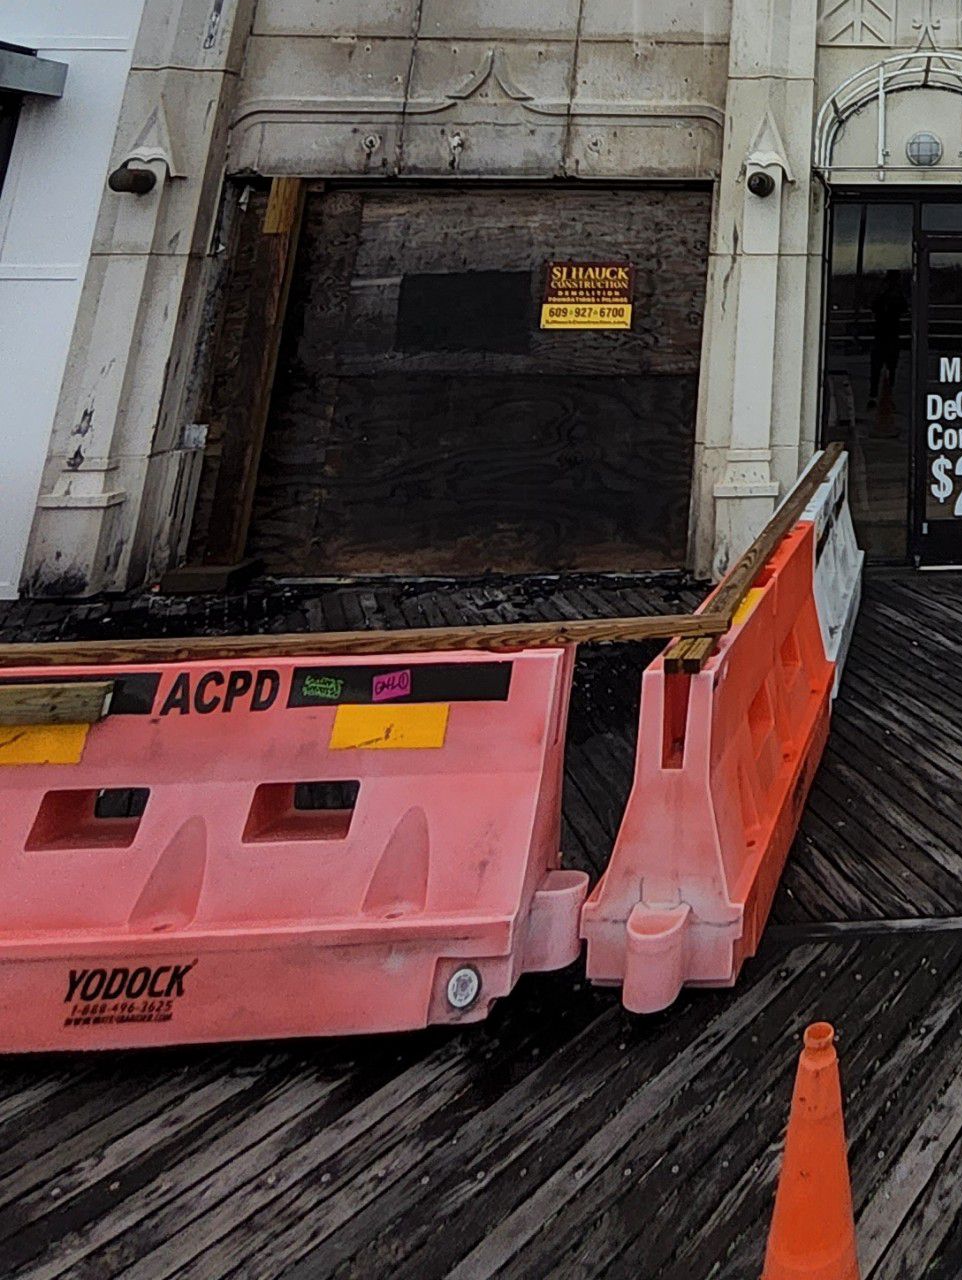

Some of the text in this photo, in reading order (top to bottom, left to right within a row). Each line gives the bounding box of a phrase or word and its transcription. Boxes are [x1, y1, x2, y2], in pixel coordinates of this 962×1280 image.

[550, 280, 629, 289] CONSTRUCTION
[571, 266, 630, 280] HAUCK
[159, 669, 280, 716] ACPD
[64, 964, 193, 1003] YODOCK
